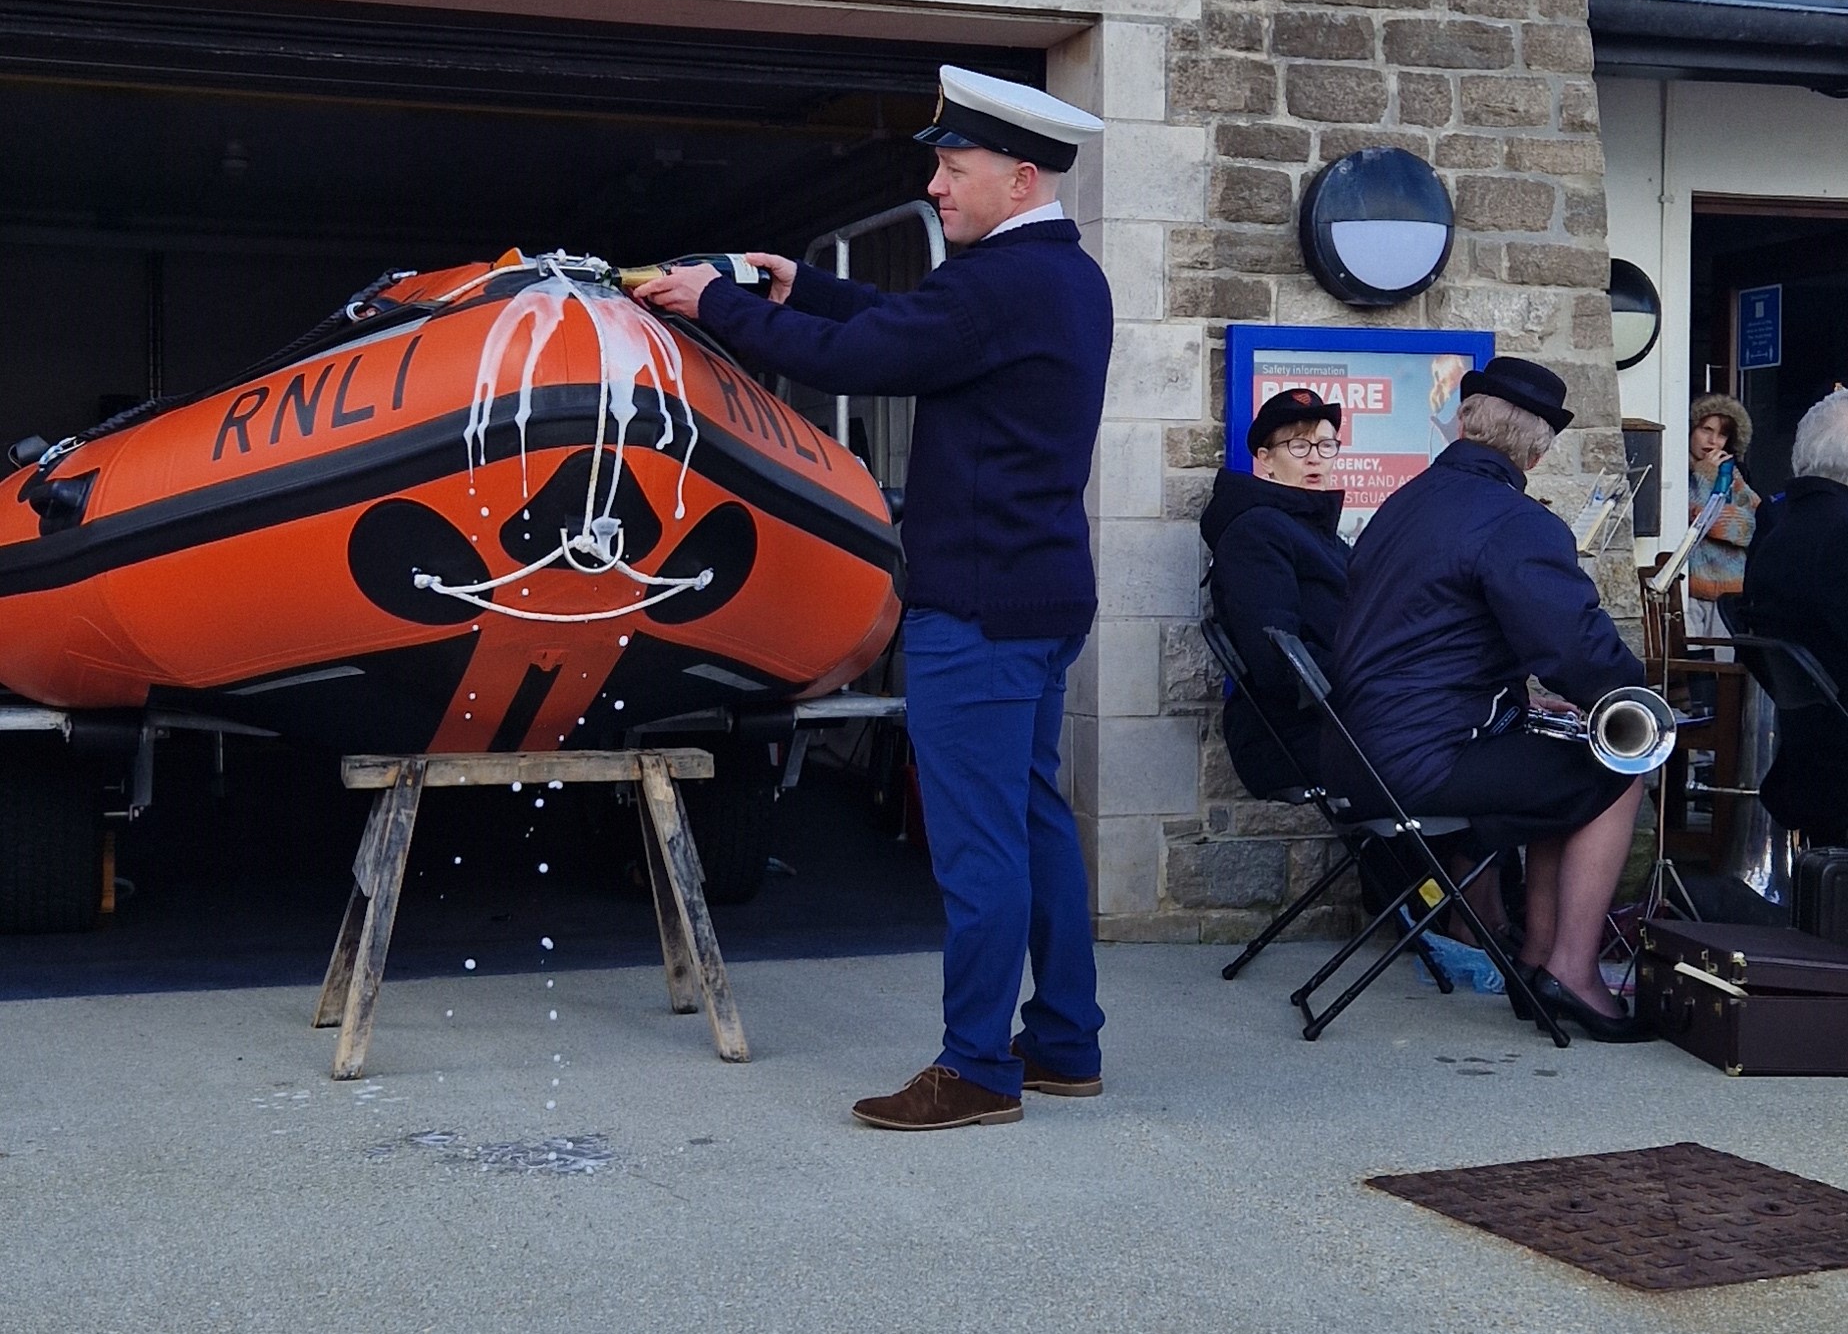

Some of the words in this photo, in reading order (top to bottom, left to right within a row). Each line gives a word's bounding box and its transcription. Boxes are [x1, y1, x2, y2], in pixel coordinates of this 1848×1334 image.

[1262, 364, 1291, 377] Safety
[1292, 365, 1345, 376] information
[212, 333, 424, 462] RNLI
[1262, 381, 1384, 409] BWARE
[702, 349, 833, 472] RNLI
[1333, 458, 1382, 472] GENCY,
[1342, 475, 1364, 487] 112
[1367, 475, 1395, 487] AND
[1345, 491, 1391, 504] STGUA
